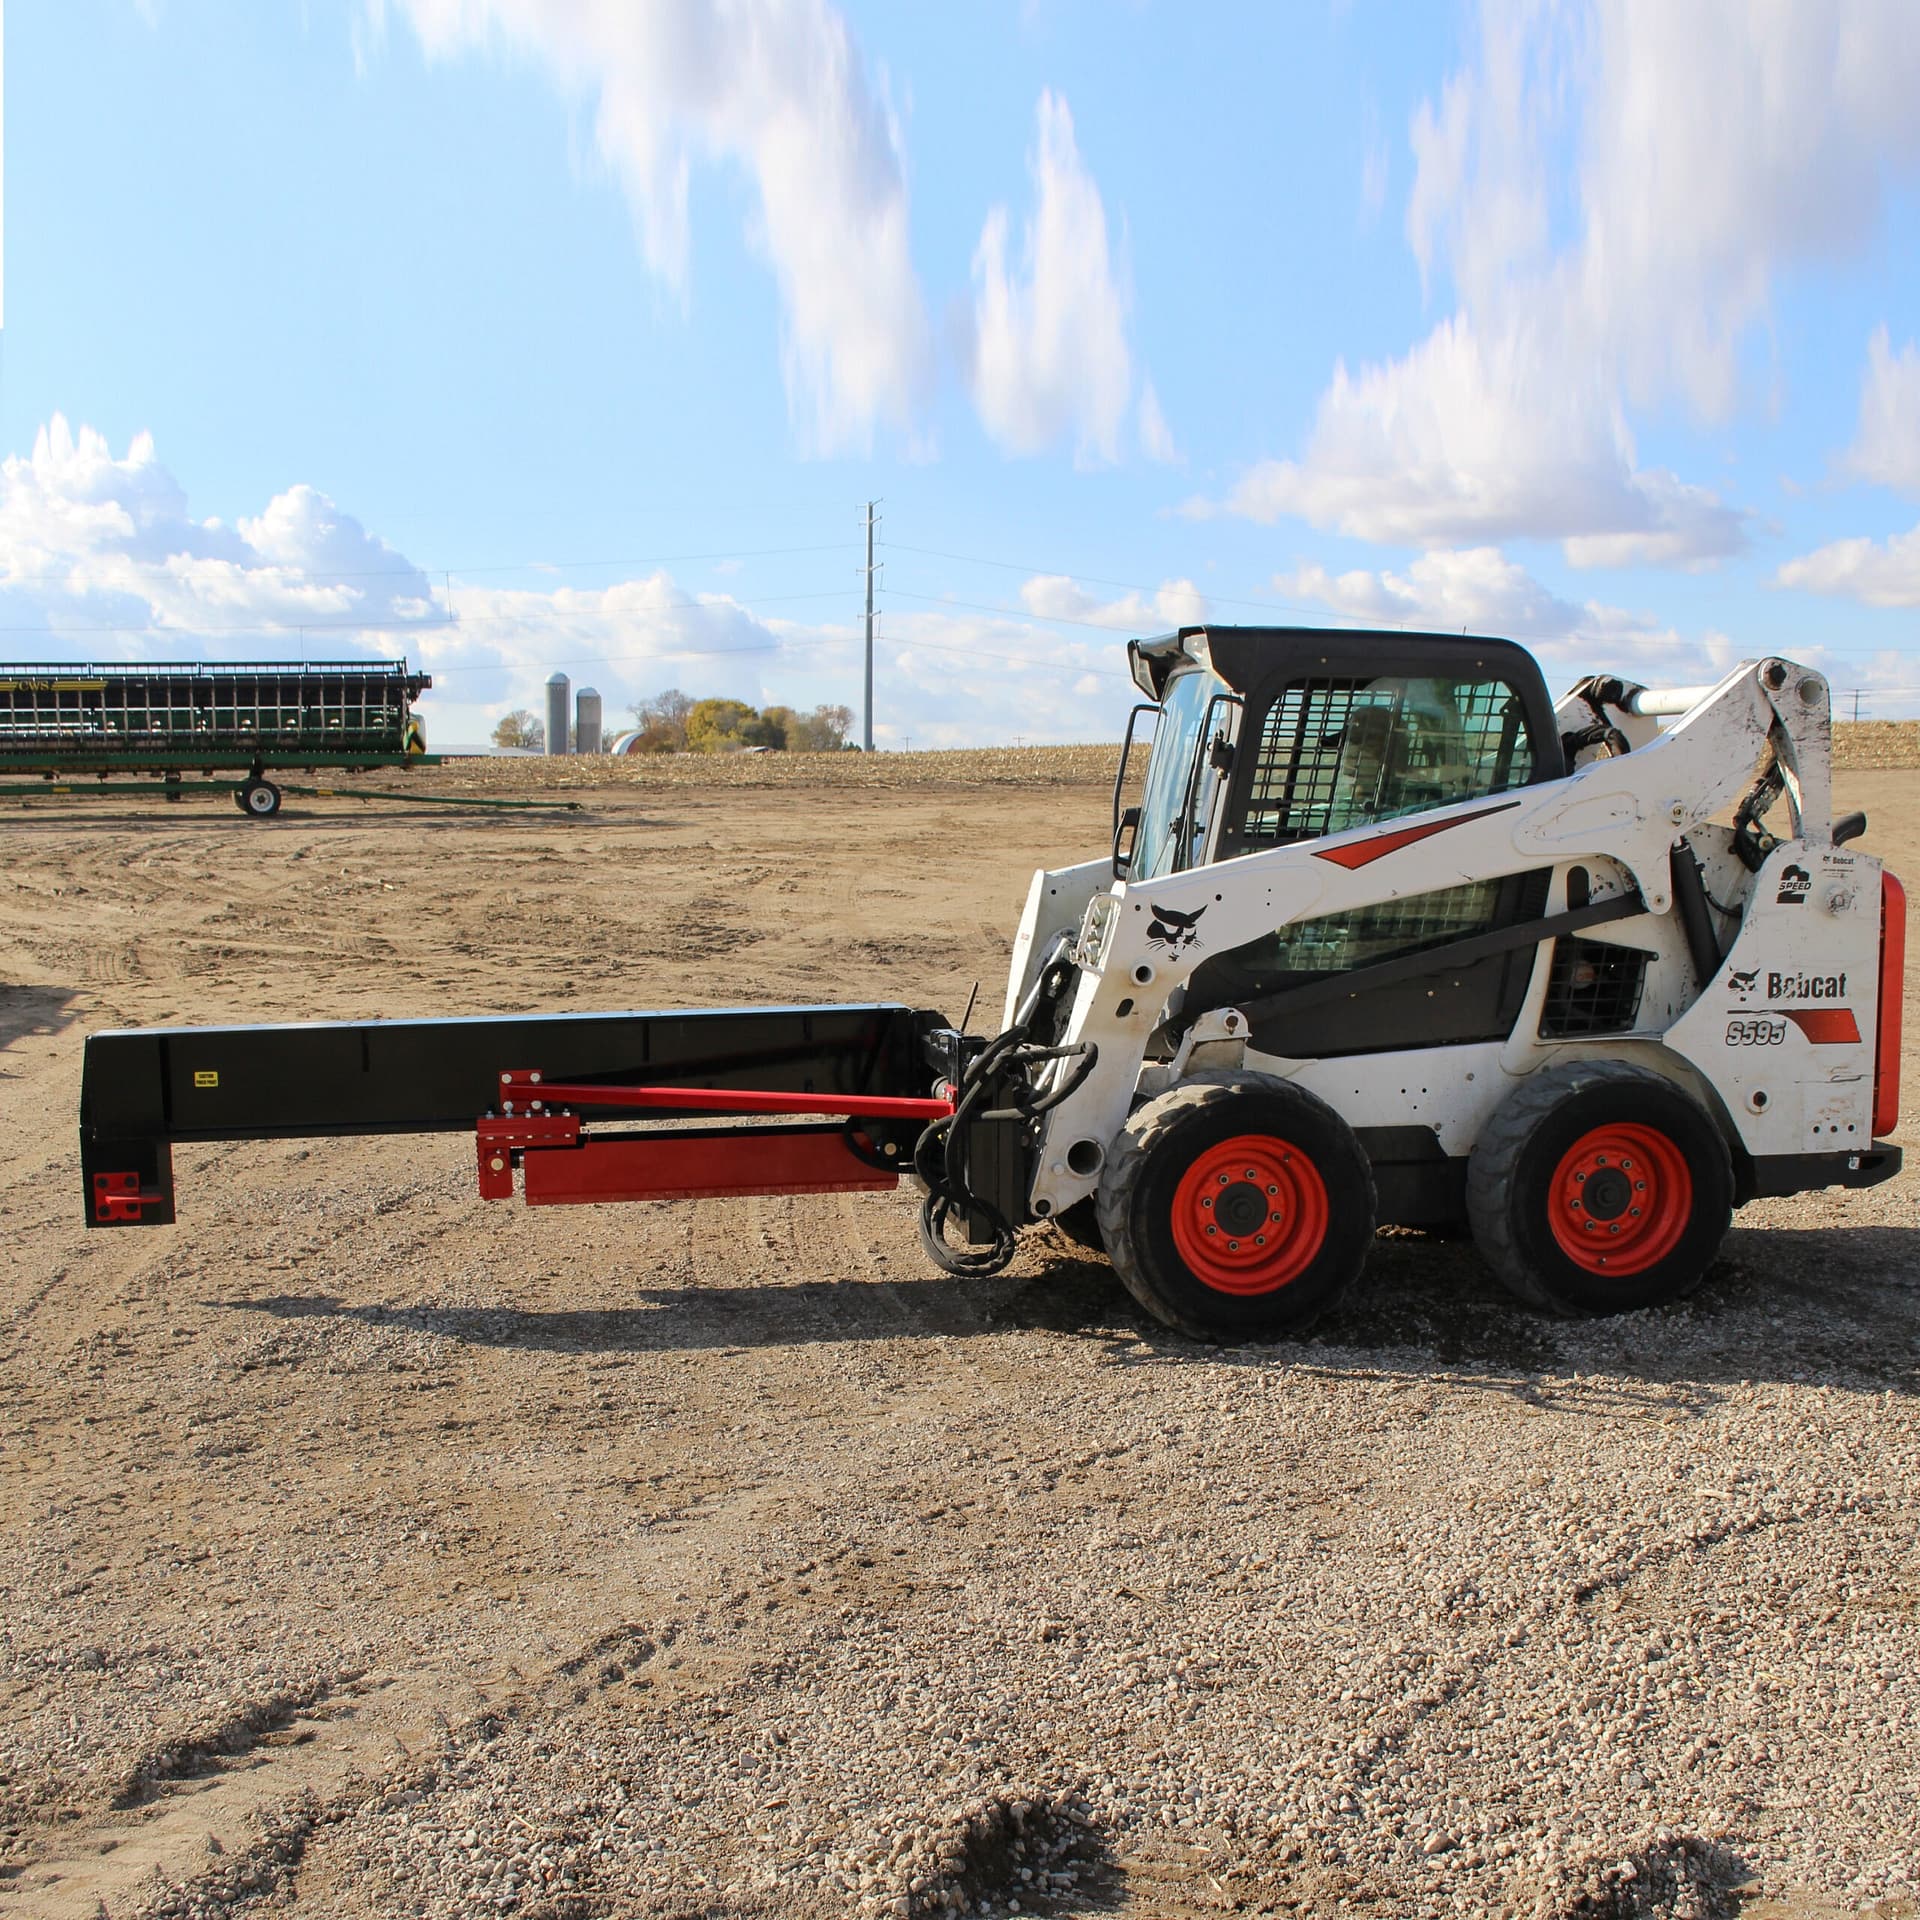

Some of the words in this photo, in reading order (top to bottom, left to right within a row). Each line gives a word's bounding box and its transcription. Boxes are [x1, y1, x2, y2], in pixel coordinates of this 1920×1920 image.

[18, 680, 49, 691] CWS
[1776, 864, 1810, 904] 2
[1778, 881, 1812, 890] SPEED
[1767, 972, 1847, 999] Bobcat
[1725, 1020, 1787, 1047] S595
